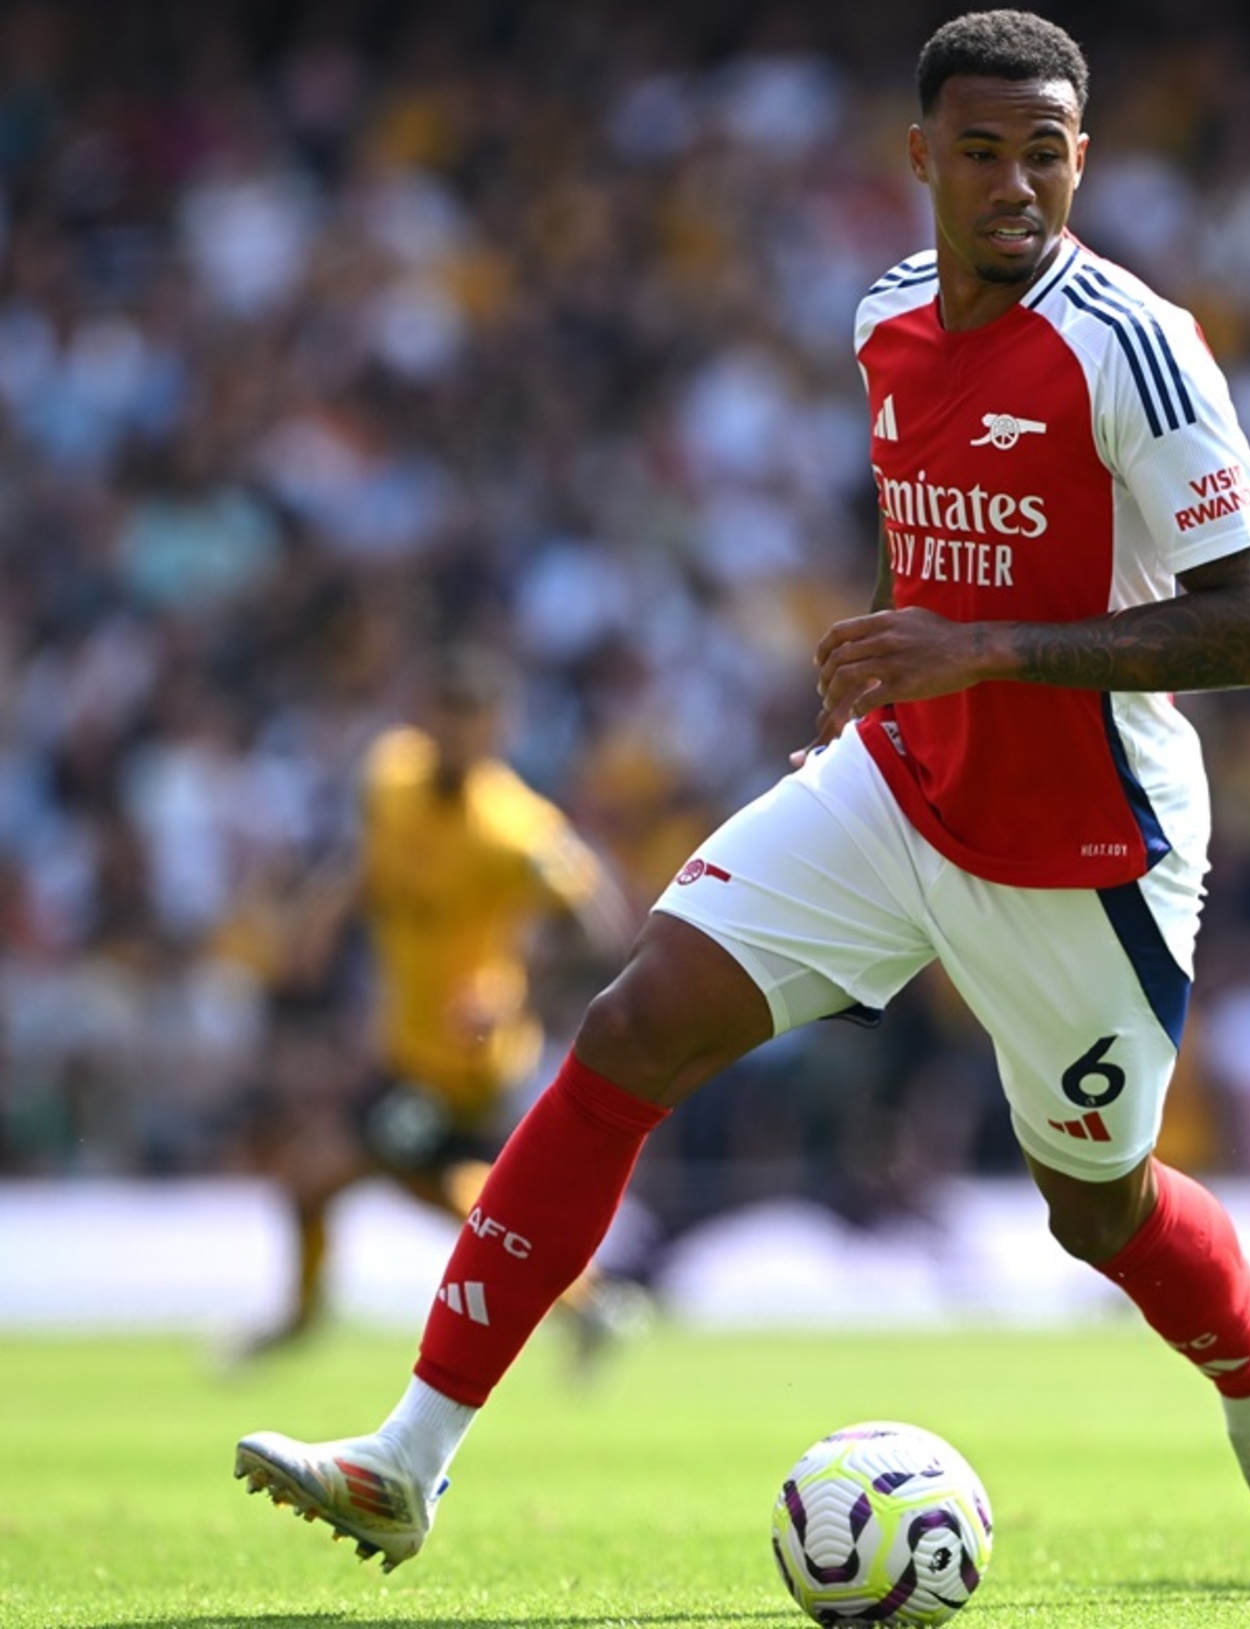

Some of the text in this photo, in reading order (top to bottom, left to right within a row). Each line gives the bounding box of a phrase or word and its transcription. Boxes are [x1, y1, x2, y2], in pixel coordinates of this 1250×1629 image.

[920, 536, 1014, 587] BETTER
[1062, 1034, 1126, 1109] 6
[468, 1206, 532, 1259] AFC
